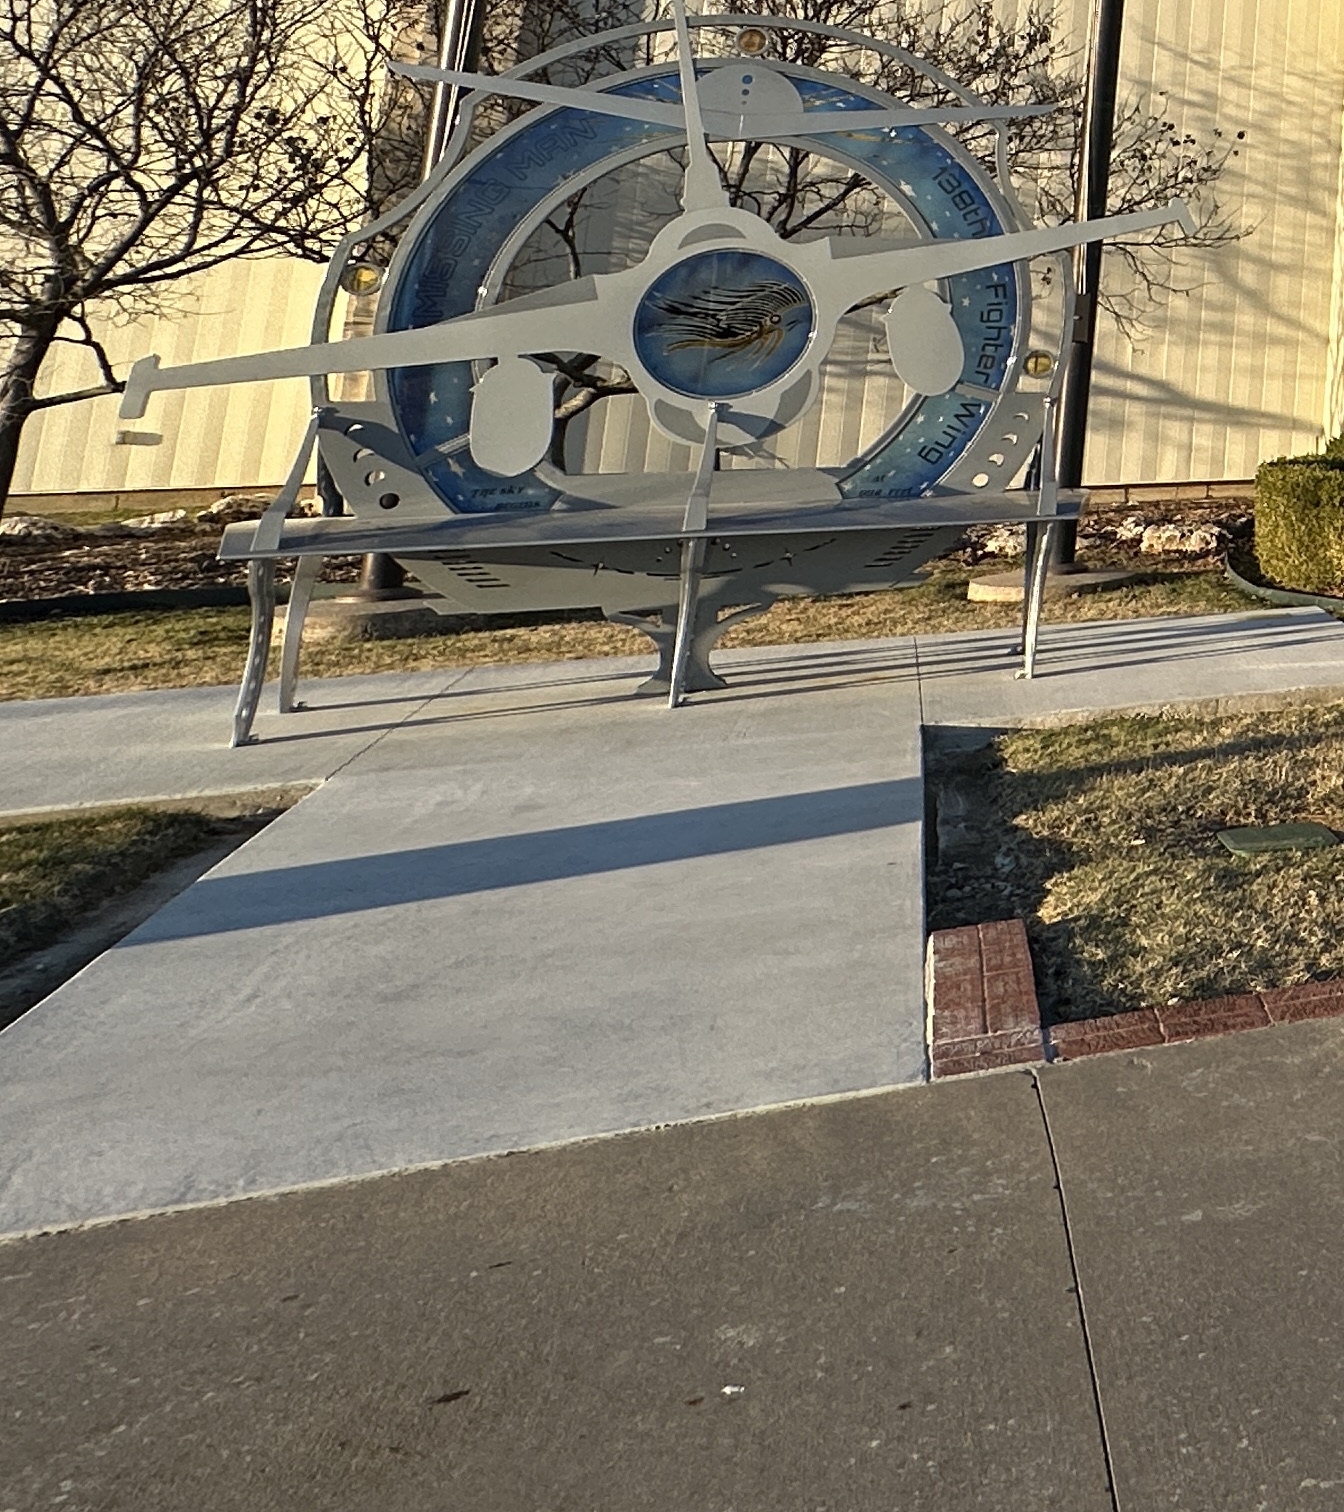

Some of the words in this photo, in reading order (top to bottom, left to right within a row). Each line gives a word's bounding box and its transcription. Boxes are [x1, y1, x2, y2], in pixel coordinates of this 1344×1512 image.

[412, 177, 510, 319] MISSING
[505, 117, 598, 182] MAN
[931, 165, 988, 239] 138th
[974, 282, 1008, 385] Fighter
[917, 401, 982, 465] Wing
